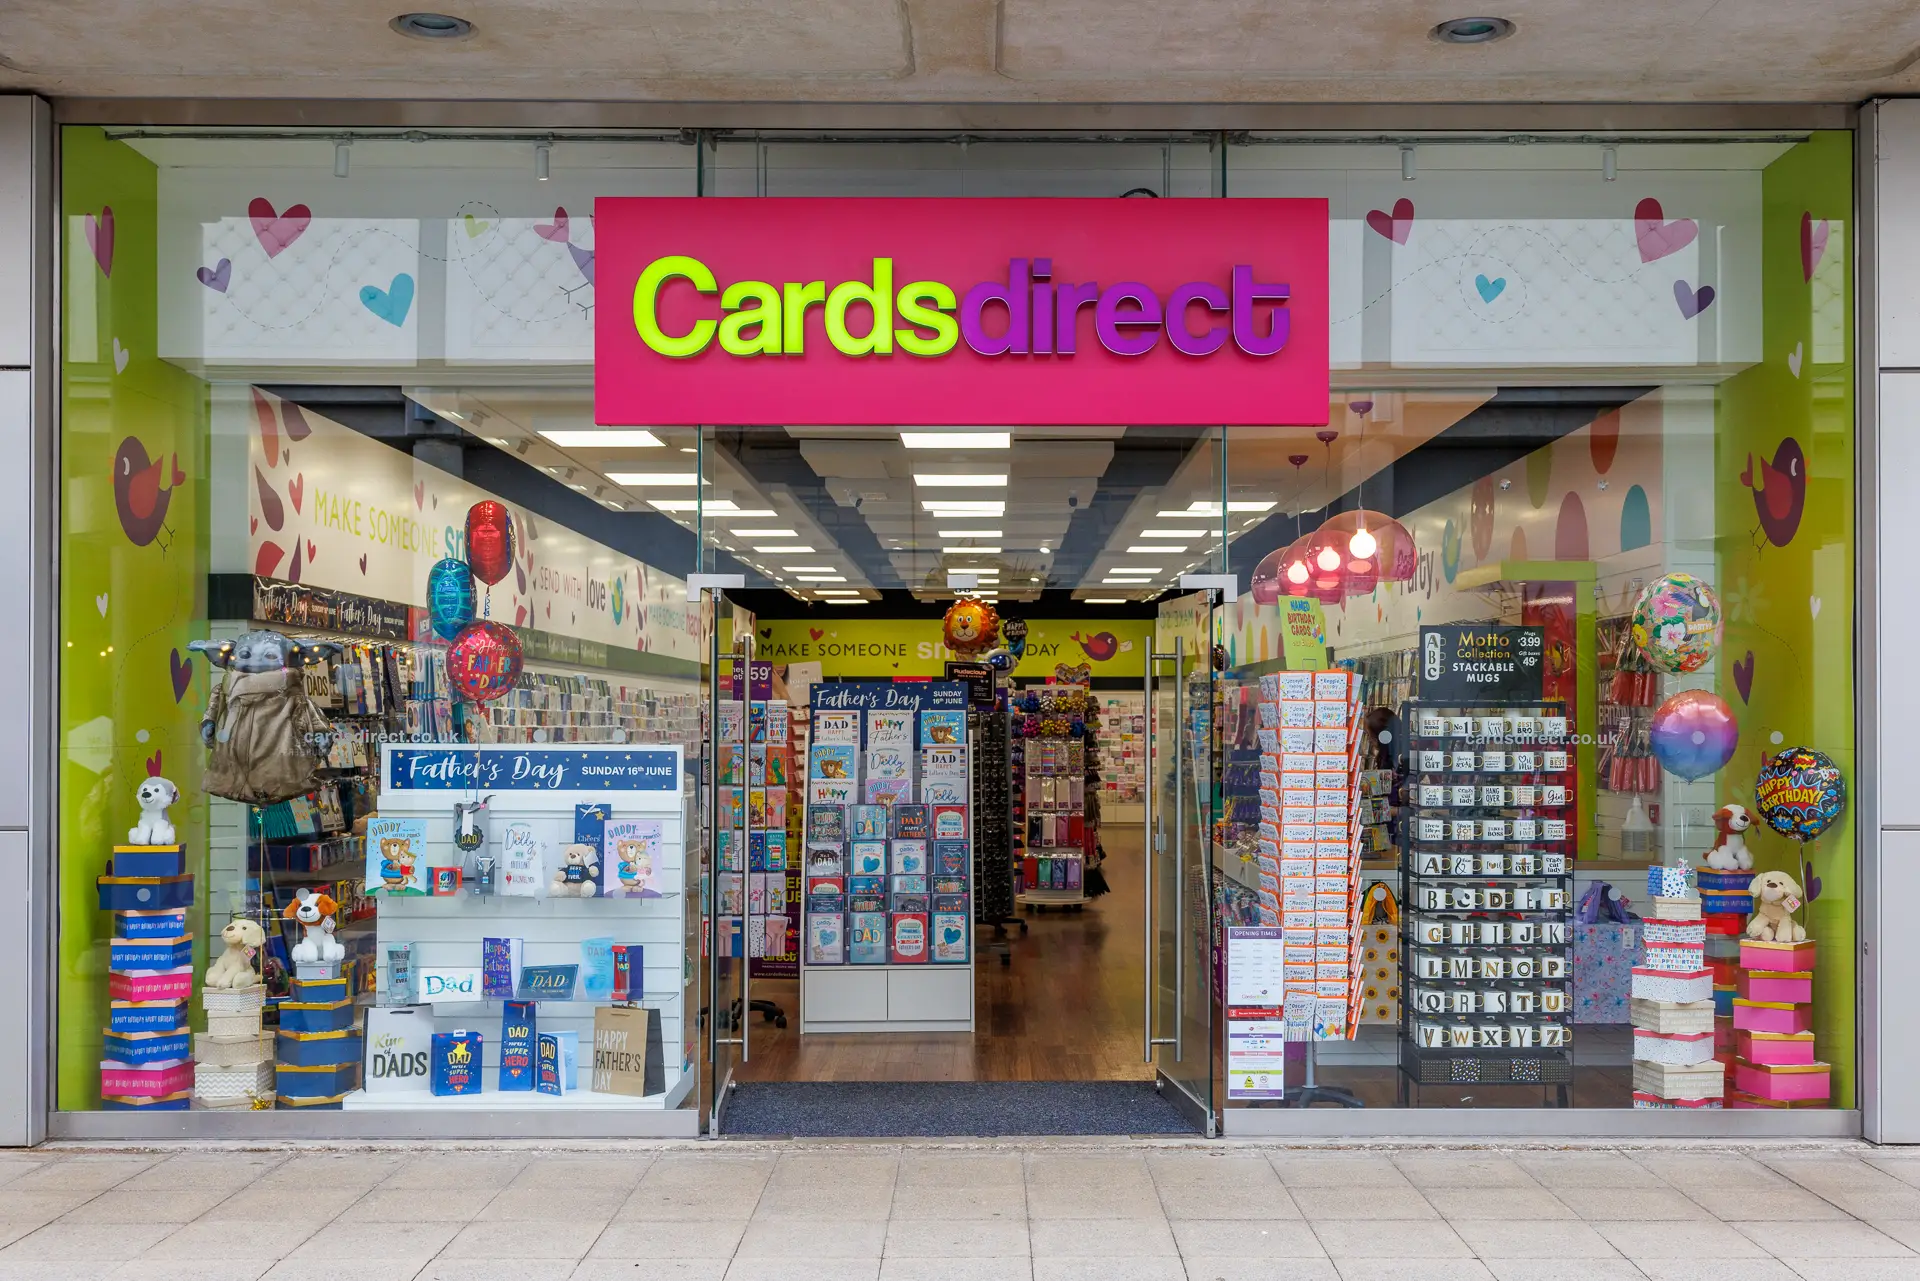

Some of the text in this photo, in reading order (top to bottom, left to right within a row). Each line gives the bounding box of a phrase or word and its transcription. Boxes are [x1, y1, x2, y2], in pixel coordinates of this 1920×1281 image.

[633, 255, 1292, 359] Cardsdirect
[314, 487, 362, 537] MAKE
[368, 510, 439, 560] SOMEONE
[540, 566, 606, 612] SEND WITH love
[340, 601, 383, 634] Father's Day
[1287, 612, 1316, 625] BIRTHDAY
[1291, 625, 1312, 636] CARDS
[1427, 634, 1438, 648] A
[1459, 631, 1510, 647] Motto
[761, 644, 810, 656] MAKE
[818, 643, 908, 657] SOMEONE
[1428, 650, 1436, 664] B
[1457, 649, 1510, 658] Collection
[1452, 663, 1514, 672] STACKABLE
[306, 675, 329, 696] DADS
[1466, 674, 1500, 682] MUGS
[816, 689, 923, 713] Father's Day
[824, 720, 849, 729] DAD
[875, 718, 904, 731] HAPPY
[1465, 730, 1618, 745] cardsdirect.co.uk
[931, 756, 957, 764] DAD
[408, 753, 672, 789] Father's Day SUNDAY 16th JUNE
[817, 788, 848, 800] HAPPY
[1757, 776, 1792, 798] HAPPY
[1547, 790, 1564, 804] Gin
[1761, 788, 1825, 812] BIRTHDAY!
[856, 820, 884, 835] DAD
[901, 817, 923, 825] DAD
[371, 822, 401, 837] DADDY
[607, 823, 638, 839] DADDY
[461, 834, 478, 845] DAD
[504, 828, 537, 854] Daddy
[577, 834, 601, 843] Cheers
[817, 858, 833, 866] DAD
[1424, 857, 1440, 873] A
[1427, 891, 1437, 909] B
[1489, 893, 1503, 907] D
[1549, 893, 1562, 907] F
[853, 929, 881, 943] DAD
[1428, 928, 1442, 942] G
[1462, 926, 1472, 943] H
[1492, 926, 1498, 943] I
[1520, 926, 1531, 942] J
[1549, 925, 1560, 943] K
[484, 941, 506, 958] Happy
[587, 946, 606, 957] DAD
[1428, 960, 1438, 977] L
[1454, 960, 1468, 978] M
[1485, 962, 1499, 977] N
[1517, 962, 1531, 976] O
[1547, 962, 1559, 976] P
[424, 973, 474, 995] Dad
[484, 973, 497, 985] Day
[532, 974, 566, 987] DAD
[1426, 994, 1441, 1013] Q
[1460, 995, 1469, 1012] R
[1497, 993, 1505, 1013] S
[1517, 995, 1531, 1011] T
[1545, 995, 1559, 1011] U
[508, 1027, 529, 1038] DAD
[596, 1029, 628, 1050] HAPPY
[1424, 1028, 1435, 1047] V
[1453, 1030, 1469, 1045] W
[1484, 1030, 1498, 1045] X
[1517, 1028, 1527, 1047] Y
[1546, 1029, 1560, 1045] Z
[384, 1048, 392, 1056] of
[447, 1051, 472, 1065] DAD
[505, 1047, 529, 1055] SUPER
[540, 1042, 556, 1059] DAD
[373, 1051, 428, 1078] DADS
[504, 1056, 529, 1067] HERO
[541, 1064, 555, 1073] SUPER
[595, 1051, 641, 1073] FATHER'S
[449, 1075, 469, 1084] HERO
[541, 1072, 556, 1082] HERO
[594, 1072, 613, 1090] DAY
